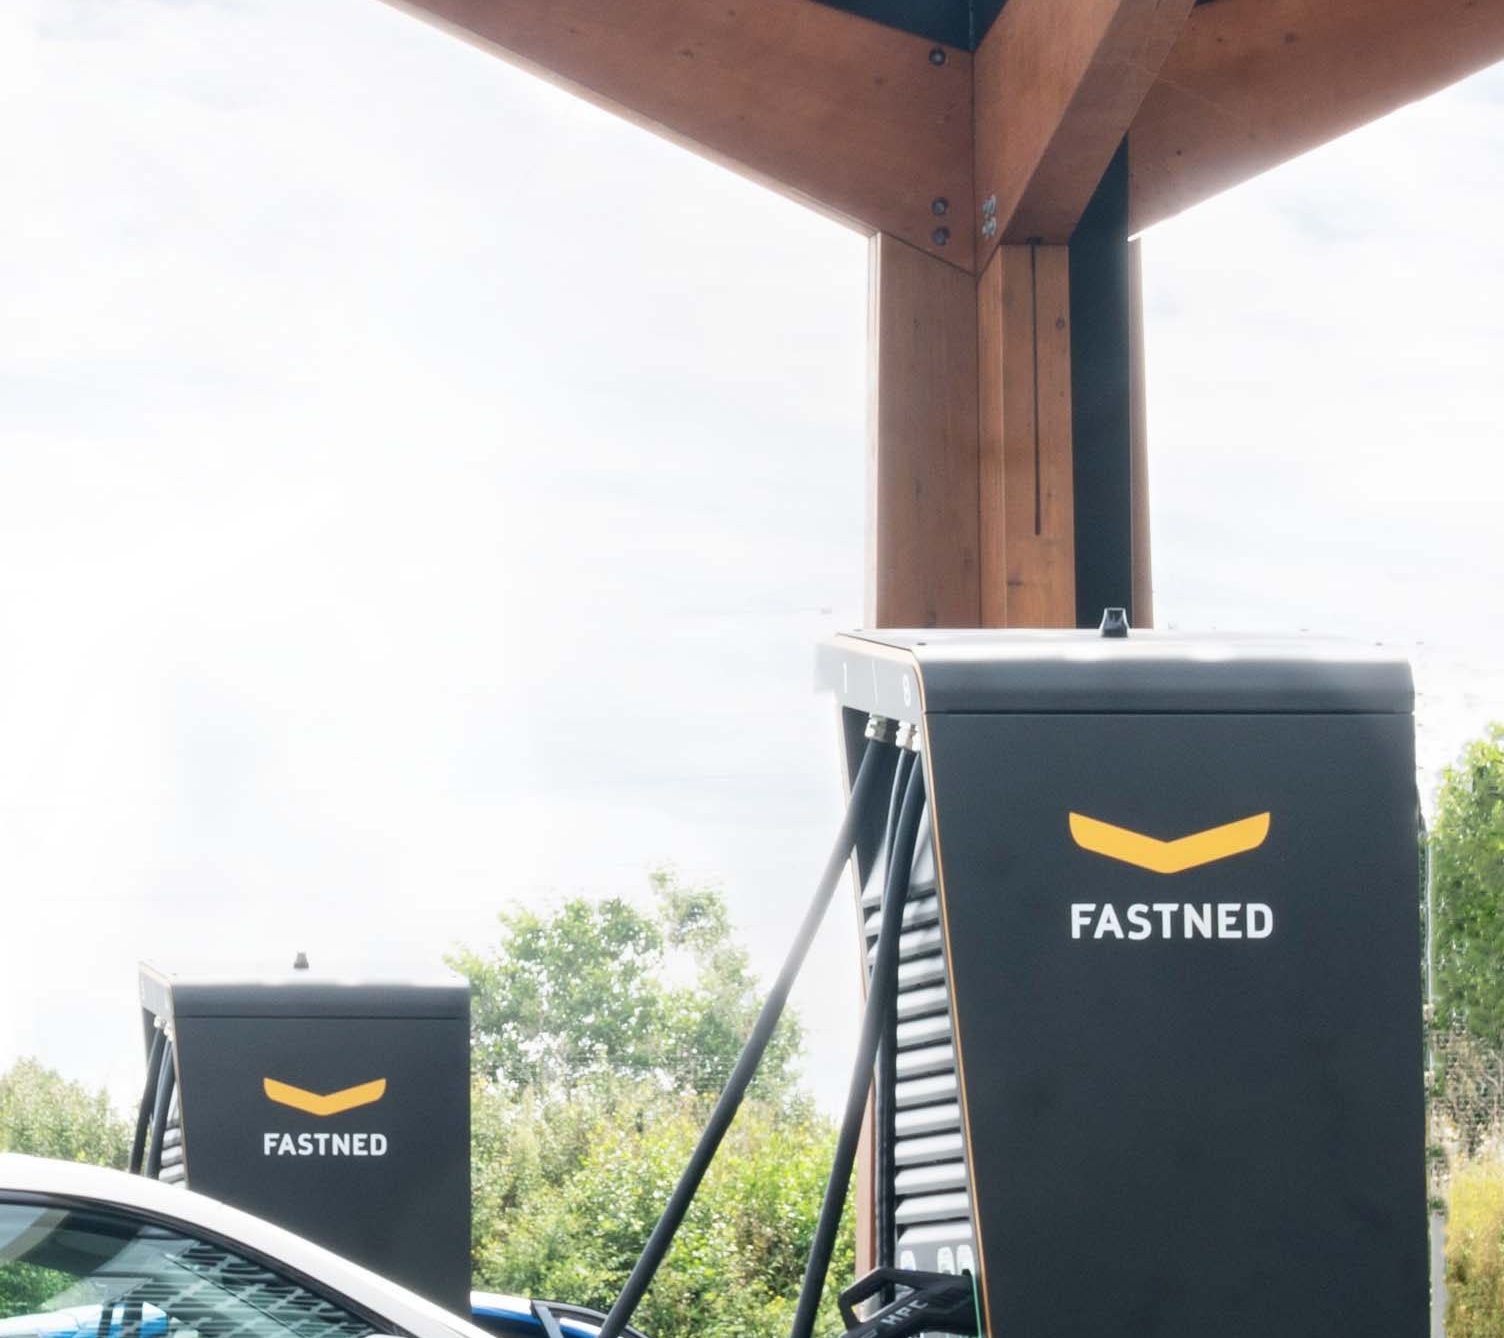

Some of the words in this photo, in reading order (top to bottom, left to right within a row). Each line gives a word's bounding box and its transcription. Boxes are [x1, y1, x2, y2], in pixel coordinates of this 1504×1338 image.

[1070, 902, 1275, 941] FASTNED
[263, 1132, 388, 1157] FASTNED
[880, 1299, 929, 1326] HPC
